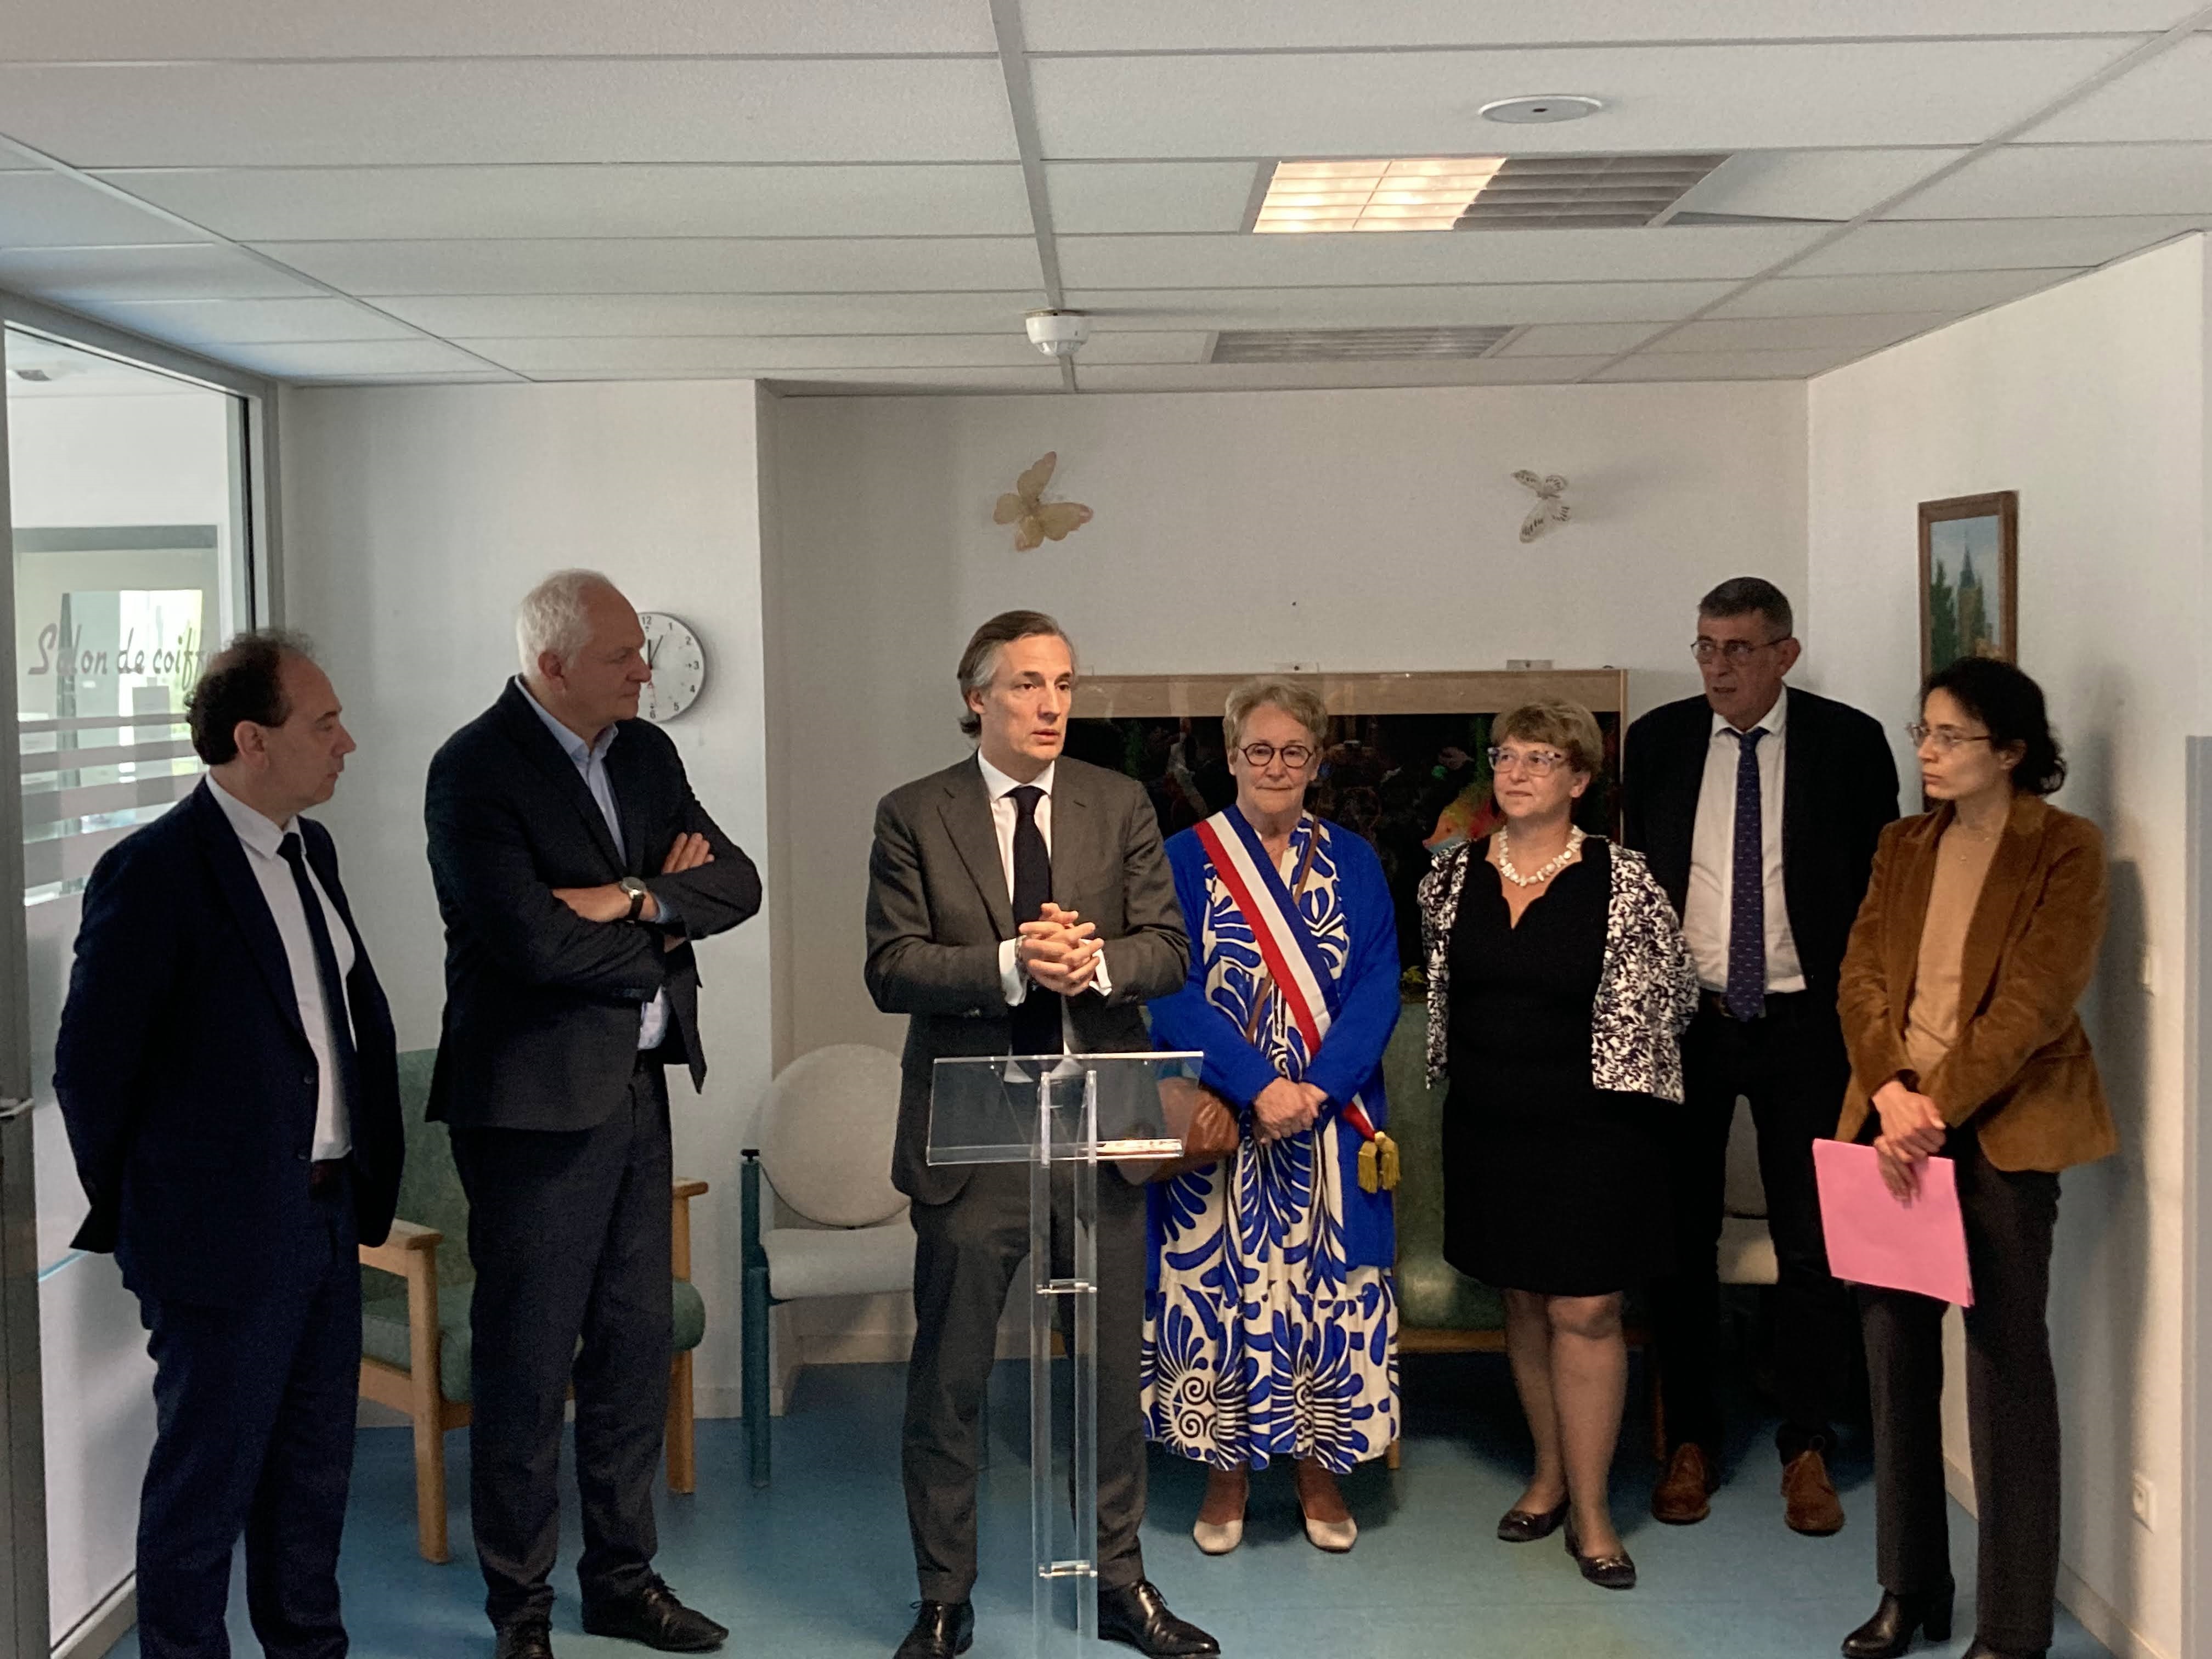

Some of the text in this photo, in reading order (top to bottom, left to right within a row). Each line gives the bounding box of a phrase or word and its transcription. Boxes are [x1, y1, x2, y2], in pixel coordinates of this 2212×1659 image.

[641, 616, 652, 625] 12
[668, 622, 673, 630] 1
[685, 636, 691, 646] 2
[27, 623, 108, 675] Salon
[117, 628, 144, 674] de
[693, 661, 699, 670] 3
[690, 685, 696, 693] 4
[673, 702, 680, 711] 5
[650, 710, 656, 719] 6
